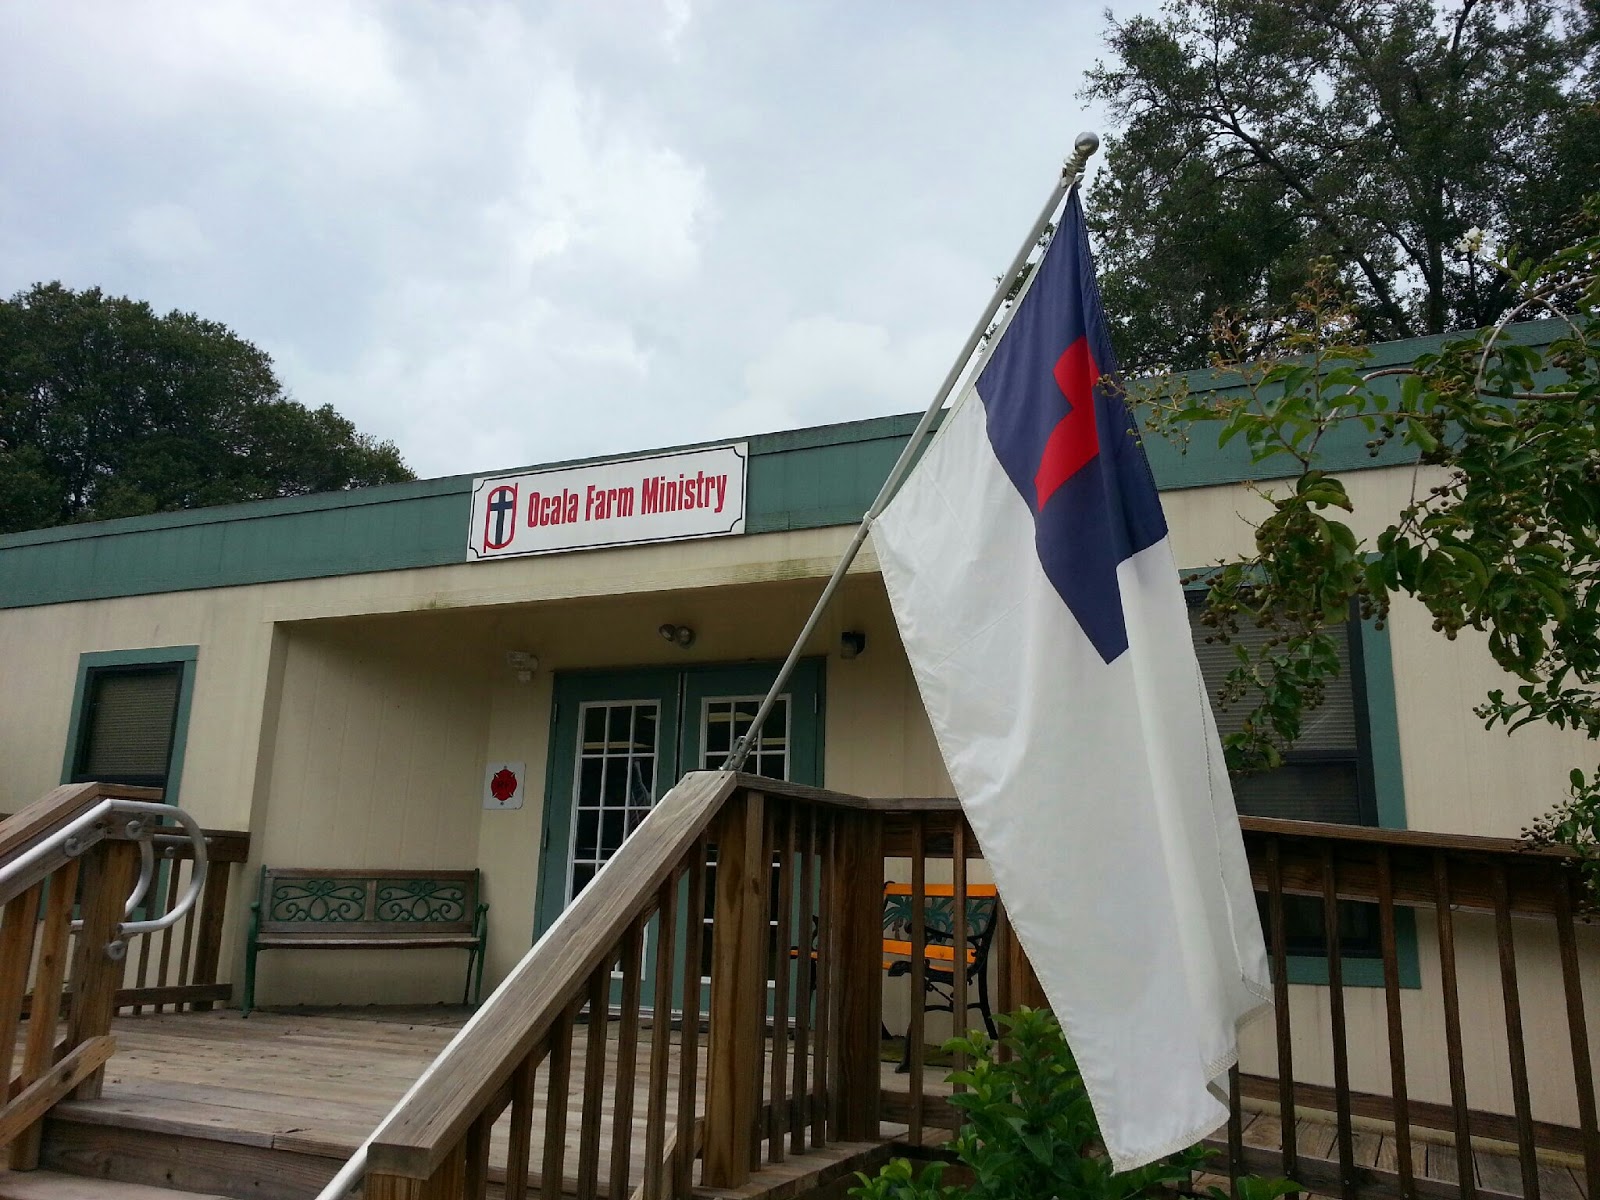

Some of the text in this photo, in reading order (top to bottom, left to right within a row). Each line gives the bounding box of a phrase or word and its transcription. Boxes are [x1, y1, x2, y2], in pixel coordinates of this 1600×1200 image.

[527, 470, 727, 528] Ocala Farm Ministry
